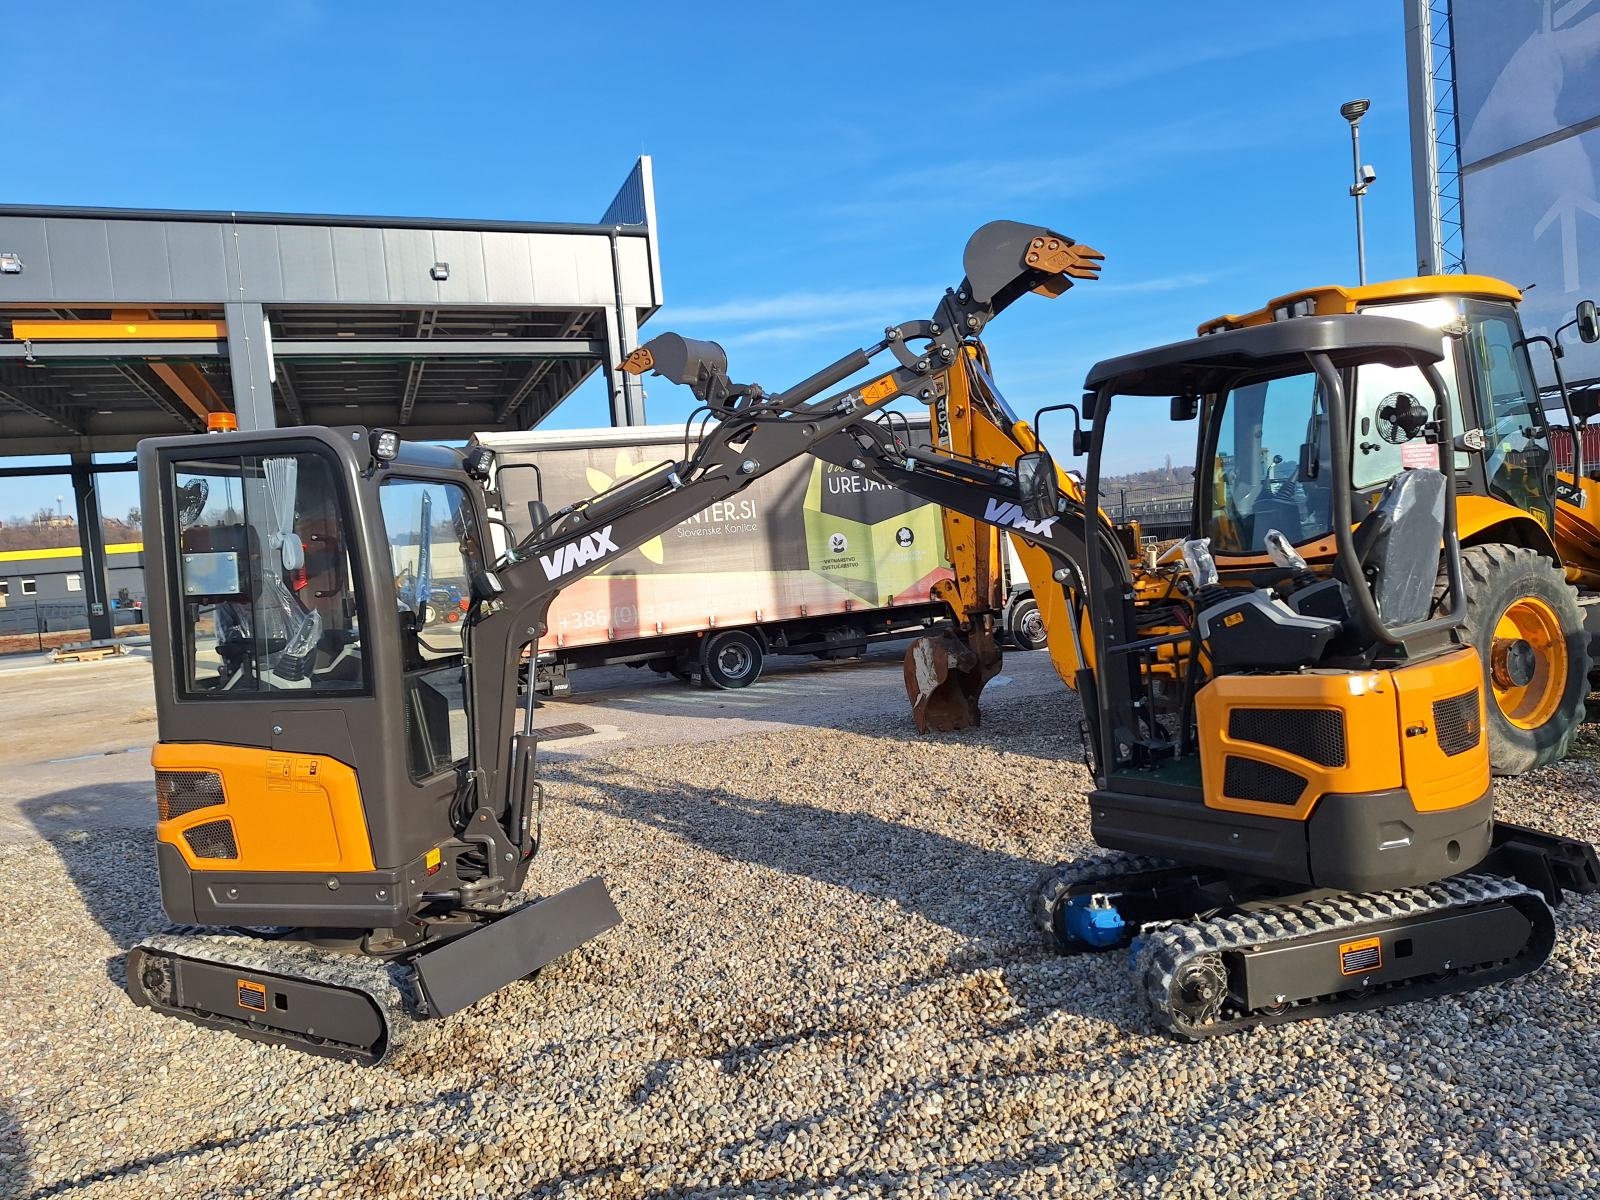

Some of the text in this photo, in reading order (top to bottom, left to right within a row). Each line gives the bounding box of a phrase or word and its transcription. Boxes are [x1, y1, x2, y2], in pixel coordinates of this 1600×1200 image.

[679, 499, 757, 525] NTER.SI
[677, 527, 722, 538] Slovenske
[539, 524, 619, 582] VMAX
[559, 609, 608, 630] +386
[613, 603, 639, 627] (0)
